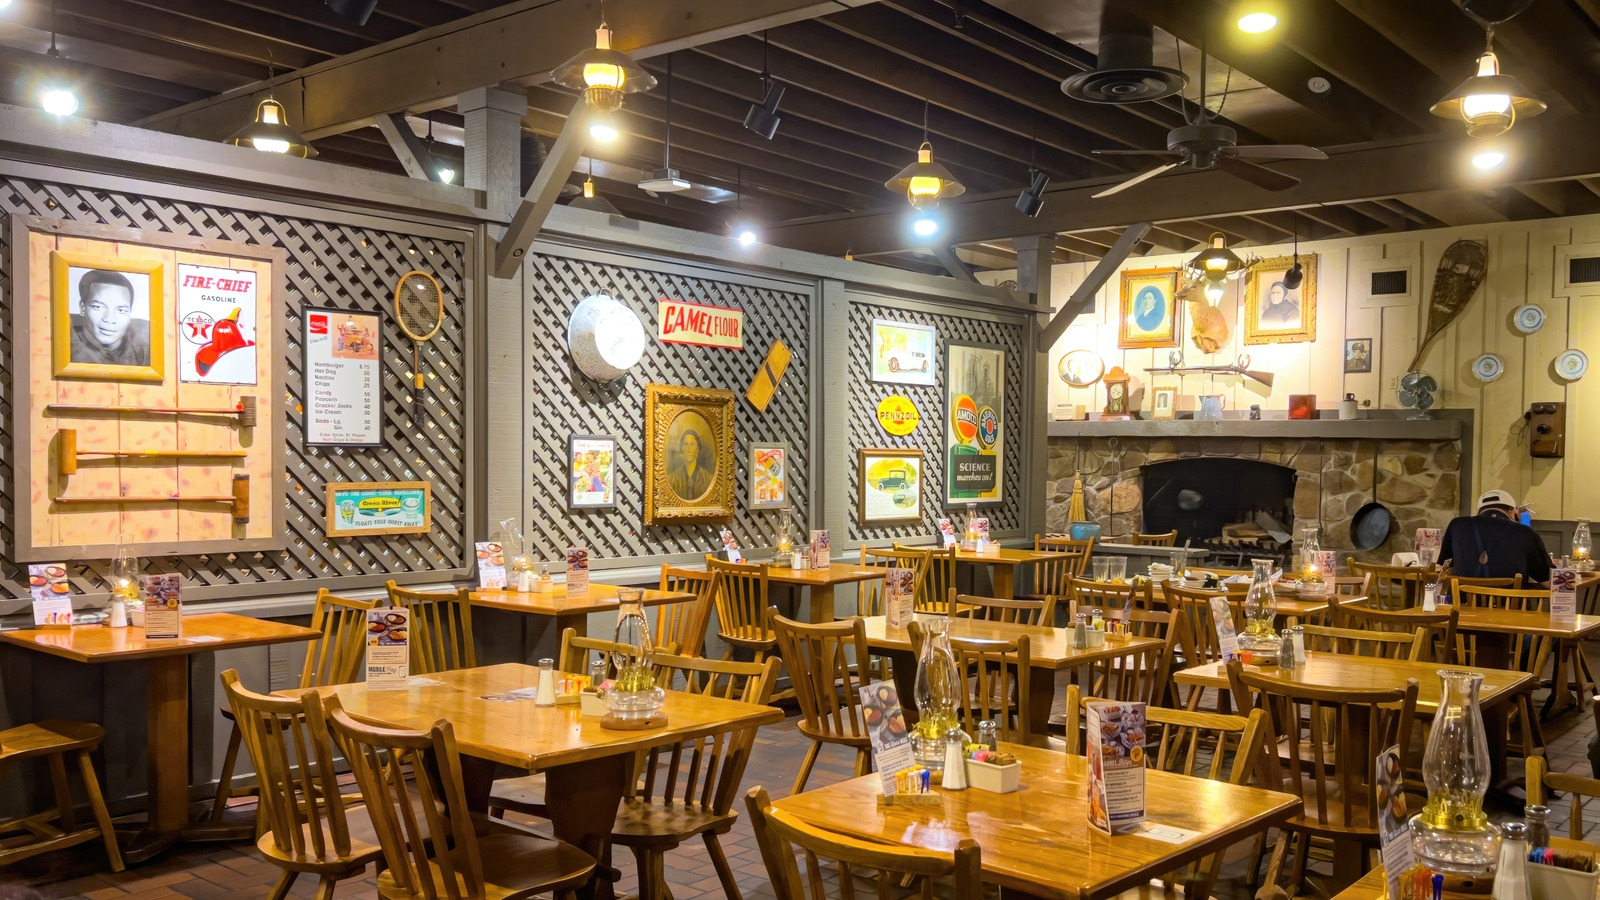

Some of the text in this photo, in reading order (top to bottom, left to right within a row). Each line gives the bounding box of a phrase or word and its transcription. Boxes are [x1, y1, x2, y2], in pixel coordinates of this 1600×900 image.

[183, 275, 252, 293] FIRE-CHIEF
[201, 295, 236, 303] GASOLINE
[663, 306, 739, 338] CAMEL FLOUR
[880, 411, 917, 420] PENNZOIL
[957, 409, 977, 425] AMOCO
[959, 463, 990, 471] SCIENCE
[957, 472, 981, 481] marches
